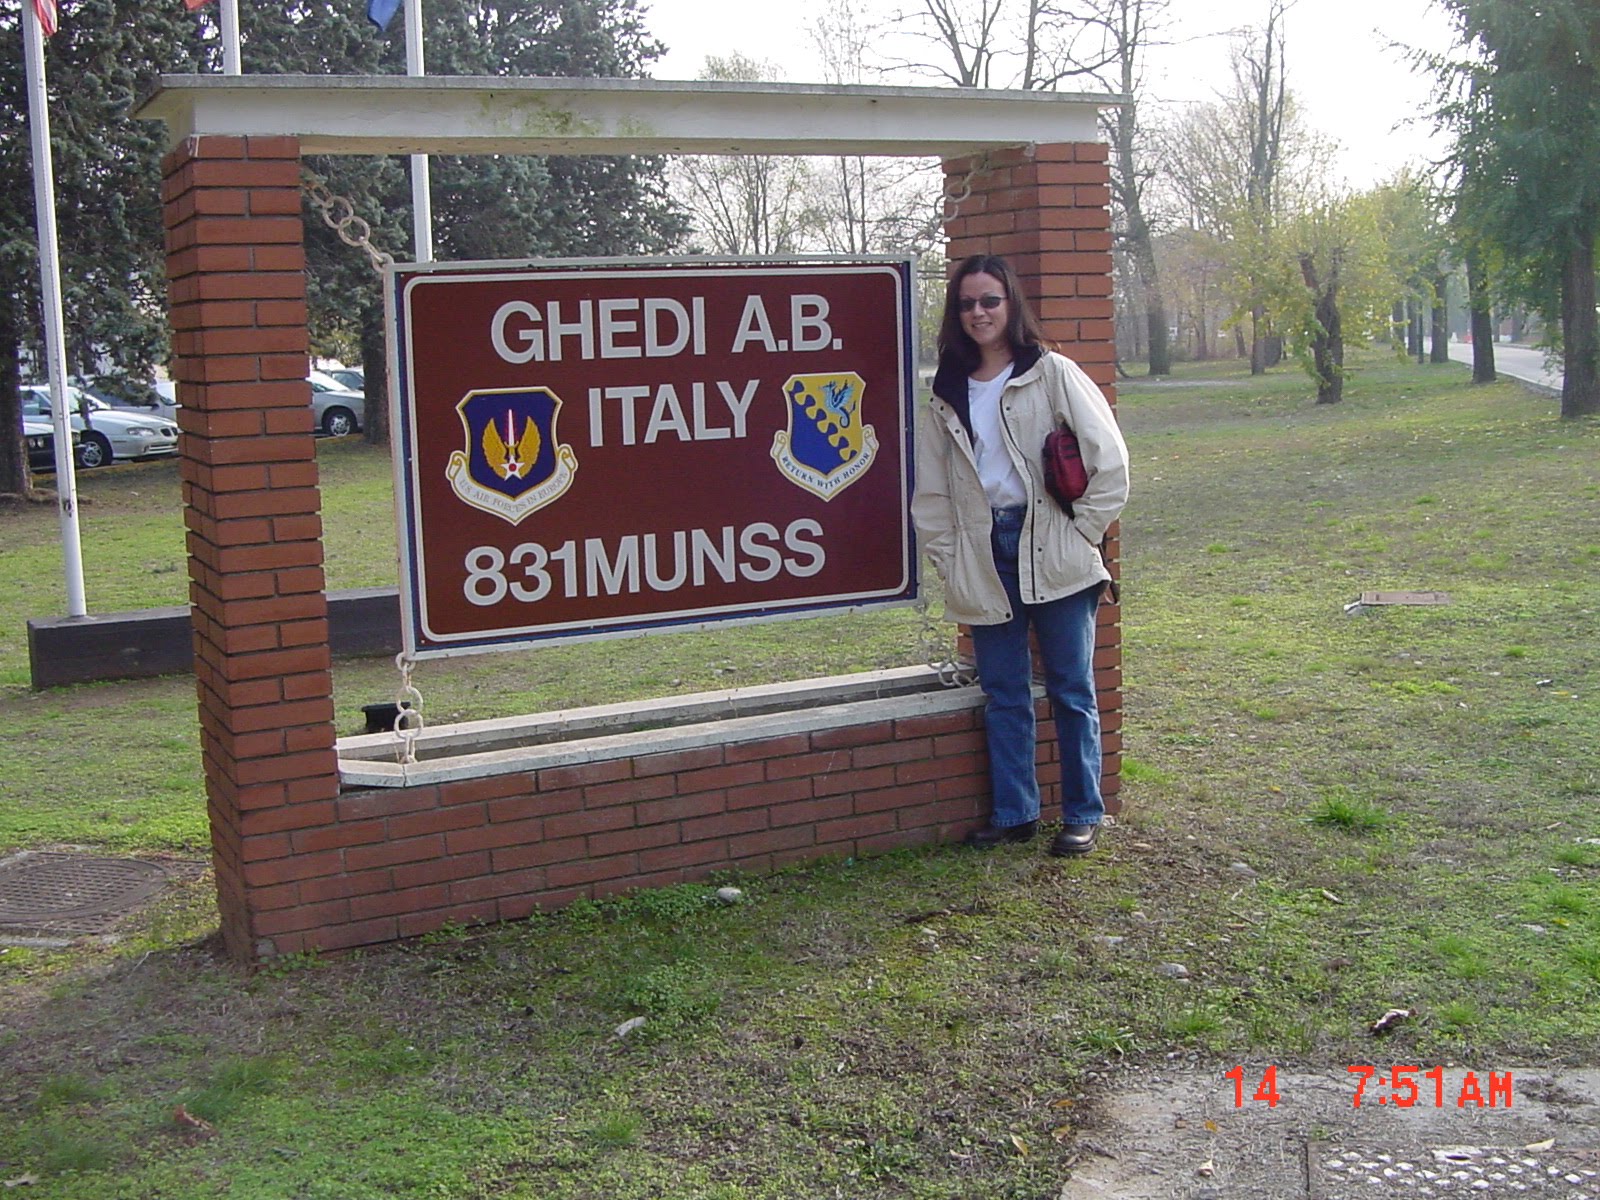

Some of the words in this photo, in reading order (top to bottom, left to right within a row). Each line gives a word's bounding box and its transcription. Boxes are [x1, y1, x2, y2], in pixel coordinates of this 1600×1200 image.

[491, 296, 706, 364] GHEDI
[731, 294, 843, 353] A.B.
[588, 379, 760, 447] ITALY
[473, 491, 489, 504] AIR
[527, 494, 537, 505] IN
[781, 455, 813, 483] RETURN
[816, 477, 841, 490] WITH
[843, 452, 871, 479] HONOR
[463, 518, 826, 607] 831MUNSS
